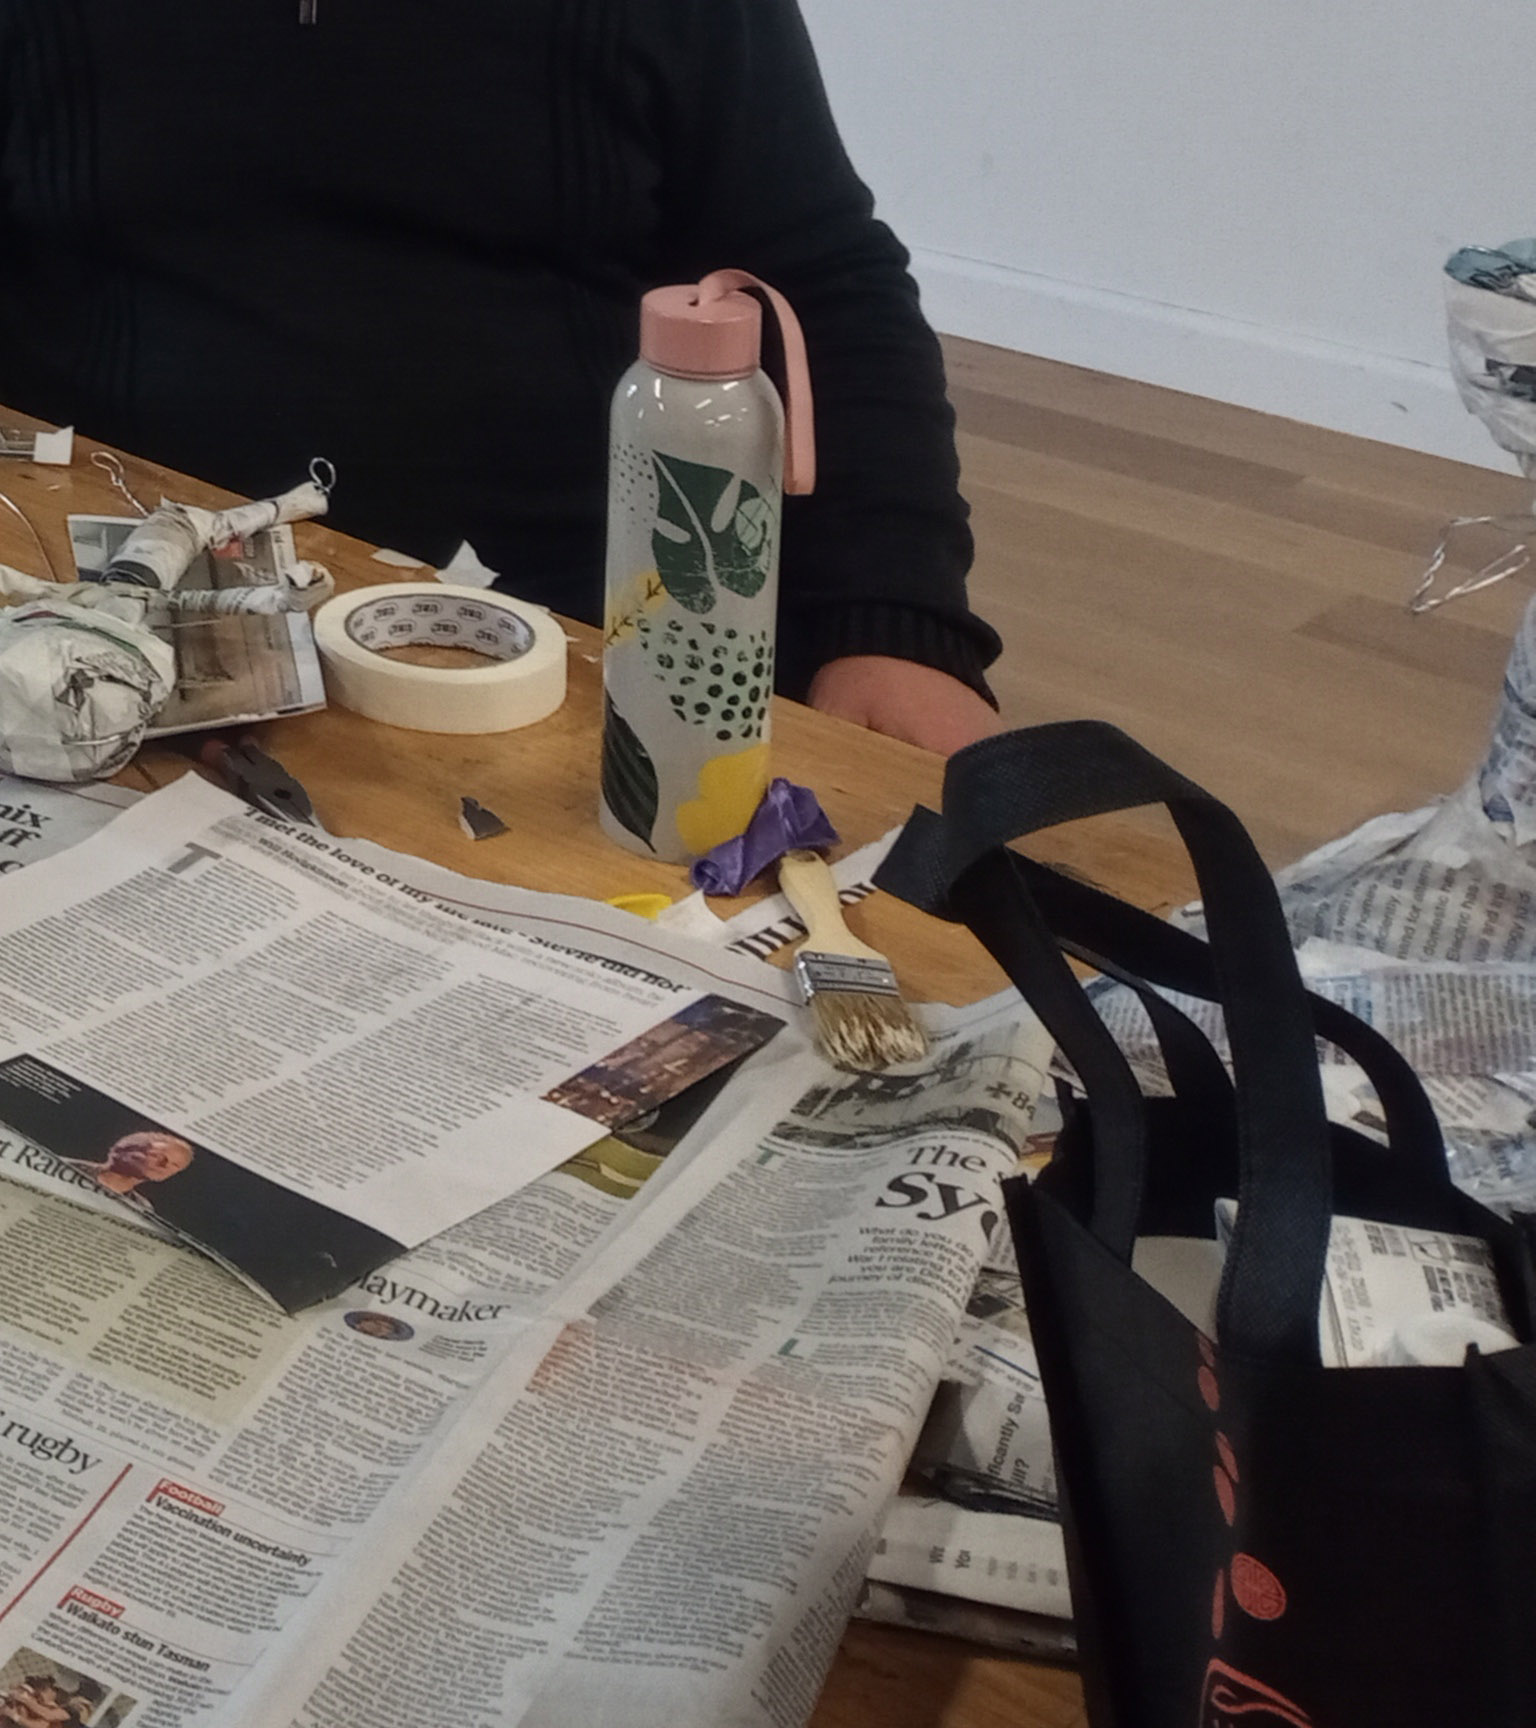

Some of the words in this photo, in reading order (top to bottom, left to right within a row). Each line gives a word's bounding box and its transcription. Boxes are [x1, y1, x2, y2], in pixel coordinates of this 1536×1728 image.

[295, 829, 331, 853] the
[329, 847, 376, 876] love
[907, 1144, 988, 1173] The
[352, 1270, 511, 1325] laymaker
[1, 1419, 102, 1474] rugby
[986, 1417, 1020, 1478] ficantly
[158, 1478, 225, 1515] Football
[154, 1495, 233, 1540] Vaccination
[232, 1531, 313, 1568] uncertainty
[69, 1586, 125, 1619] Rugby
[64, 1600, 121, 1637] Waikato
[123, 1628, 155, 1655] stun
[156, 1642, 212, 1673] Tasman
